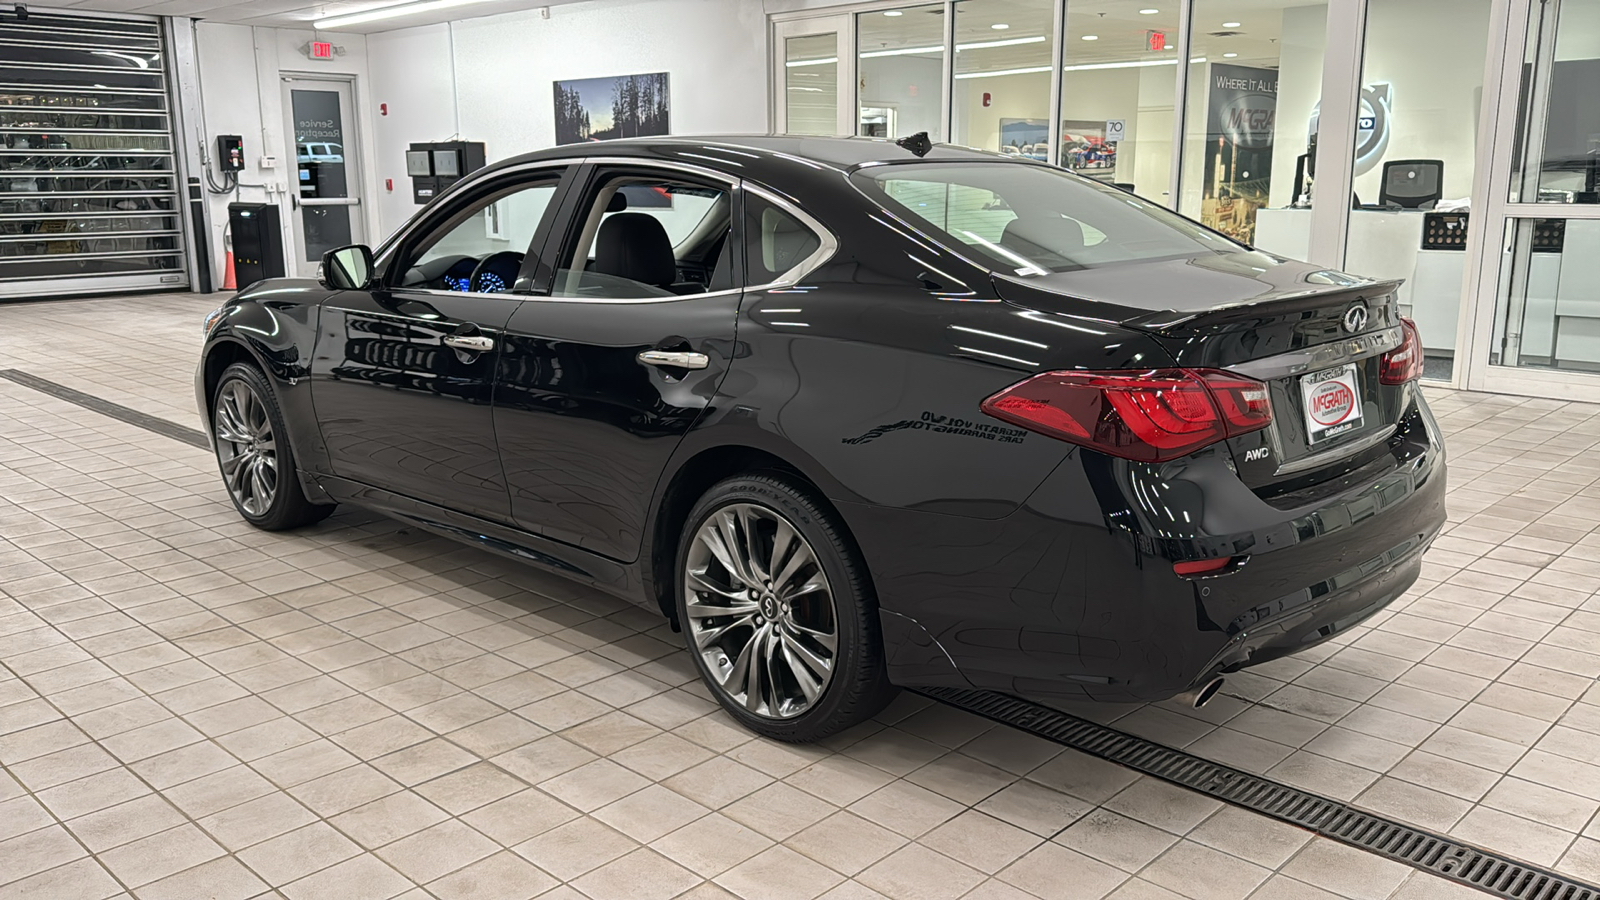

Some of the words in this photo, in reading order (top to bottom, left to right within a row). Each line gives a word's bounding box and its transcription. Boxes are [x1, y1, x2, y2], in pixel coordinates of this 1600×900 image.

[313, 42, 331, 58] EXIT
[1216, 76, 1248, 90] WHERE
[1249, 79, 1257, 90] IT
[1257, 80, 1273, 92] ALL
[1109, 122, 1123, 132] 70
[1245, 447, 1269, 462] AWD
[730, 485, 810, 525] GOODYEAR
